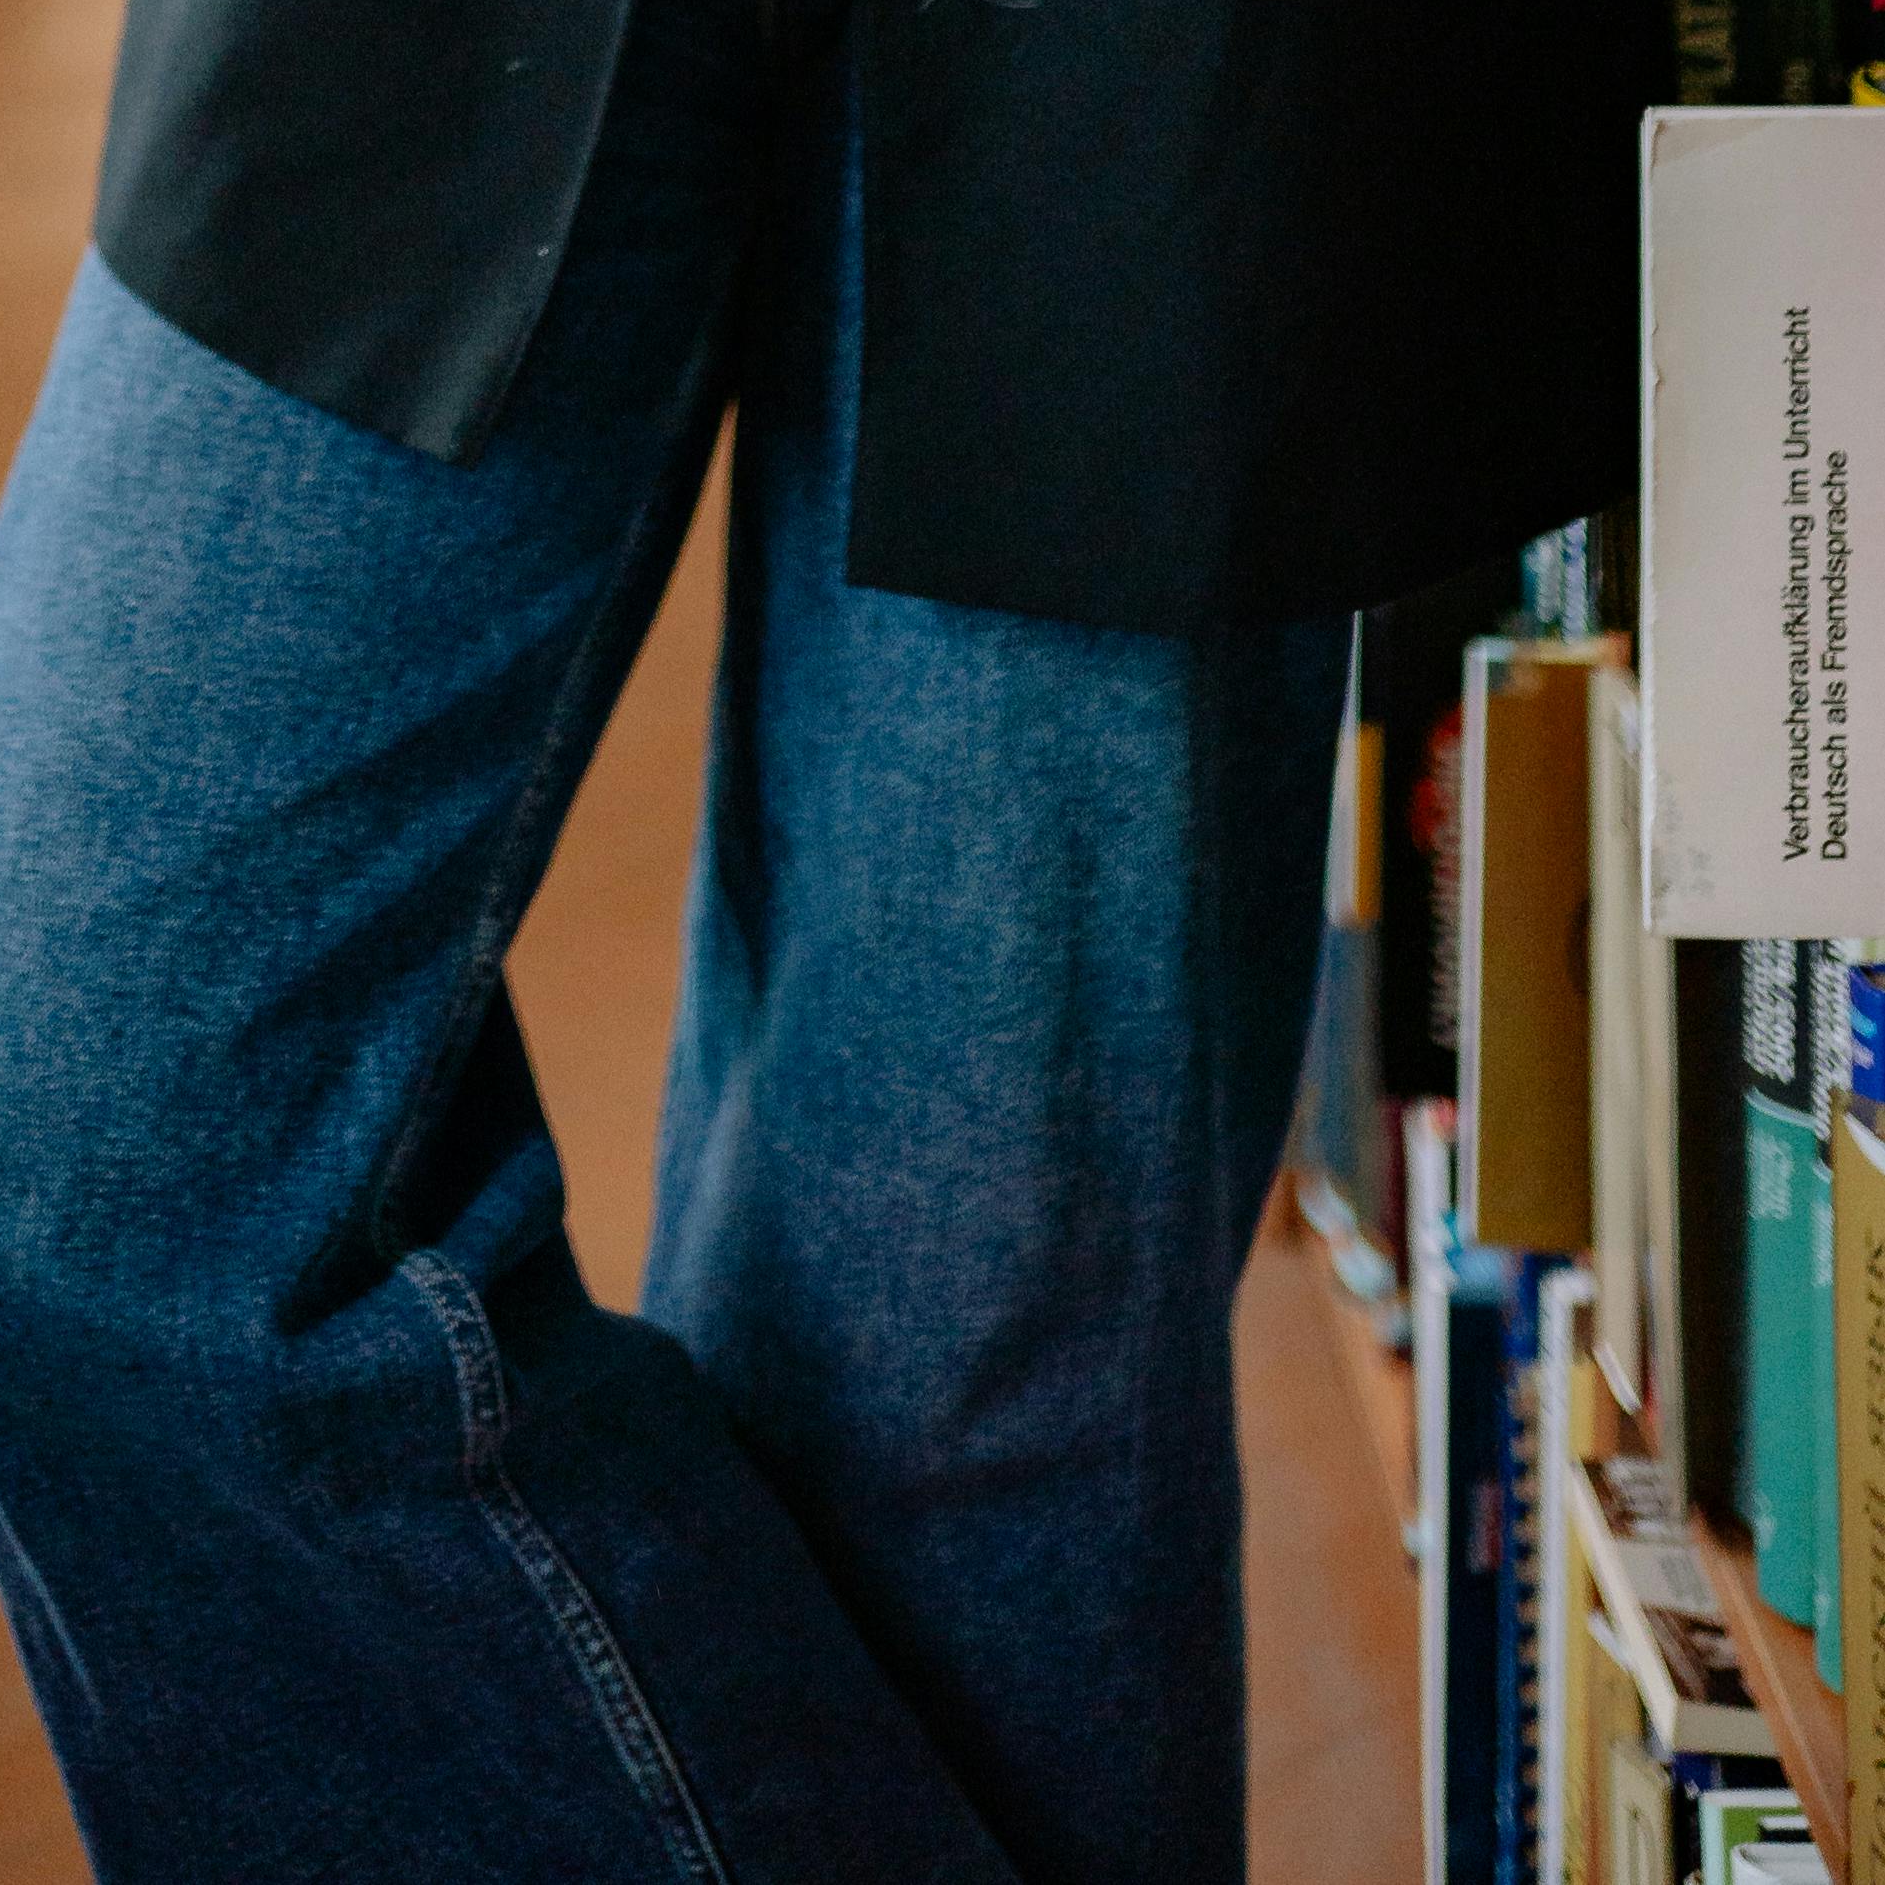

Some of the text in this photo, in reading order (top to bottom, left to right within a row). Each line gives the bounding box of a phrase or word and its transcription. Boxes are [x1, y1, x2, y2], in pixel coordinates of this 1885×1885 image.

[1781, 304, 1815, 861] Verbraucheraufklärung im Unterricht
[1820, 449, 1853, 860] Deutsch als Fremdsprache
